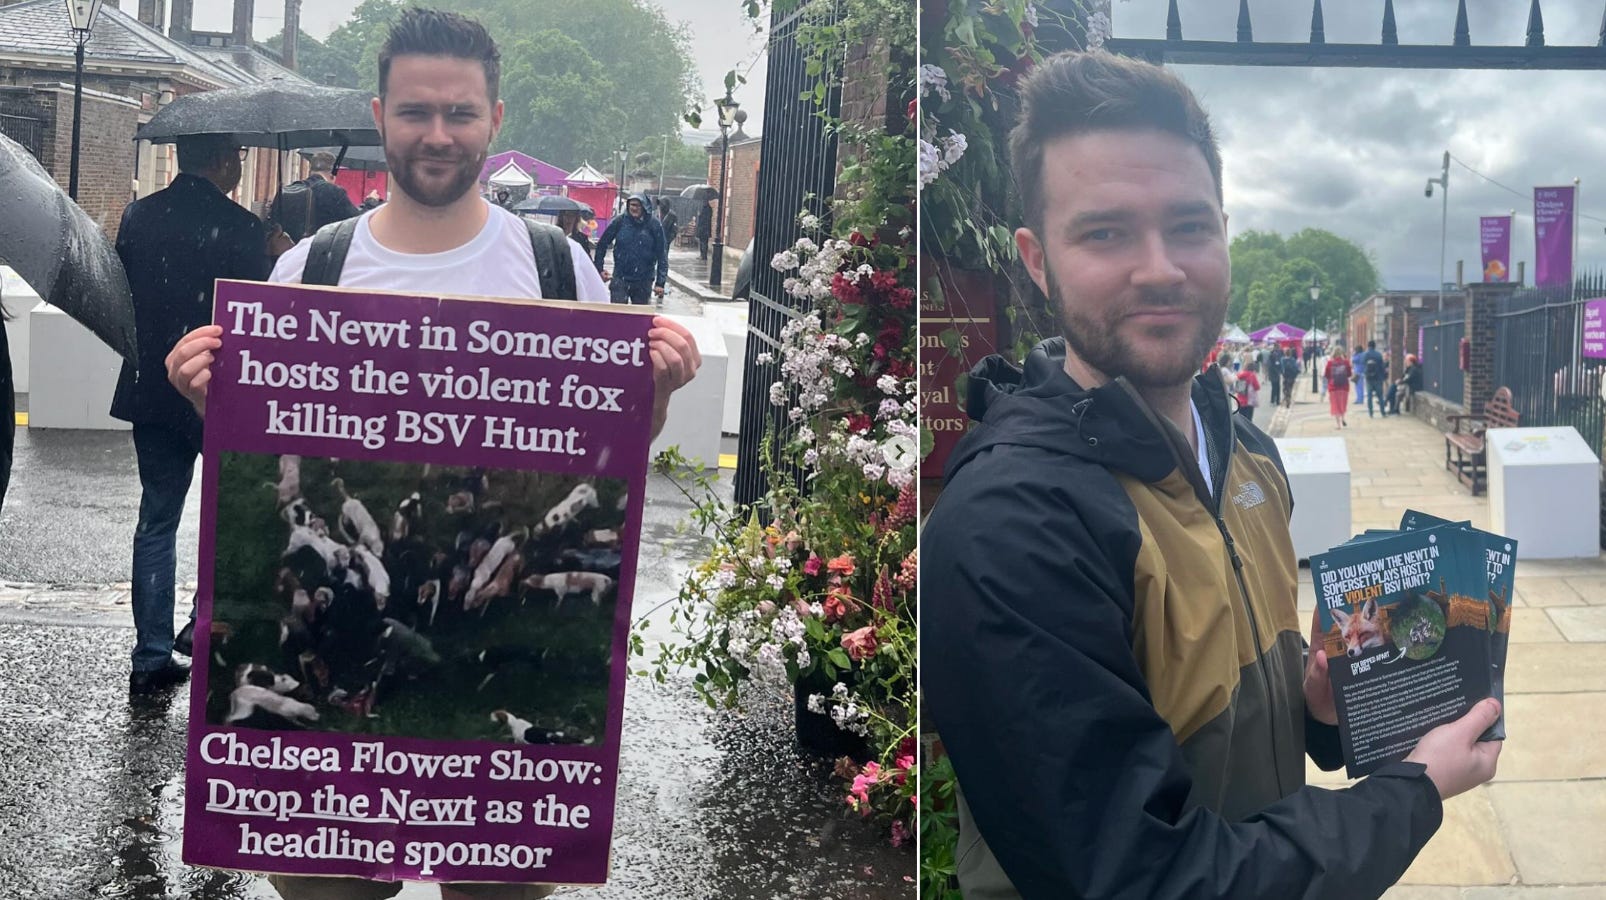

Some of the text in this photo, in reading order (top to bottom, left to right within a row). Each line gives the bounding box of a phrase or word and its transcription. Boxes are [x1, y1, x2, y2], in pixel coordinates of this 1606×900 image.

[228, 300, 645, 367] The Newt in Somerset
[238, 349, 625, 412] hosts the violent fox
[265, 400, 587, 456] killing BSV Hunt.
[1320, 570, 1337, 585] DID
[1337, 564, 1357, 581] YOU
[1358, 558, 1386, 579] KNOW
[1385, 554, 1403, 569] THE
[1403, 547, 1429, 565] NEWT
[1429, 545, 1440, 558] IN
[1322, 559, 1435, 597] SOMERSET PLAYS HOST TO
[1324, 572, 1431, 610] THE VIOLENT BSV HUNT?
[199, 732, 603, 785] Chelsea Flower Show:
[206, 778, 591, 829] Drop the Newt as the
[238, 822, 553, 876] headline sponsor
